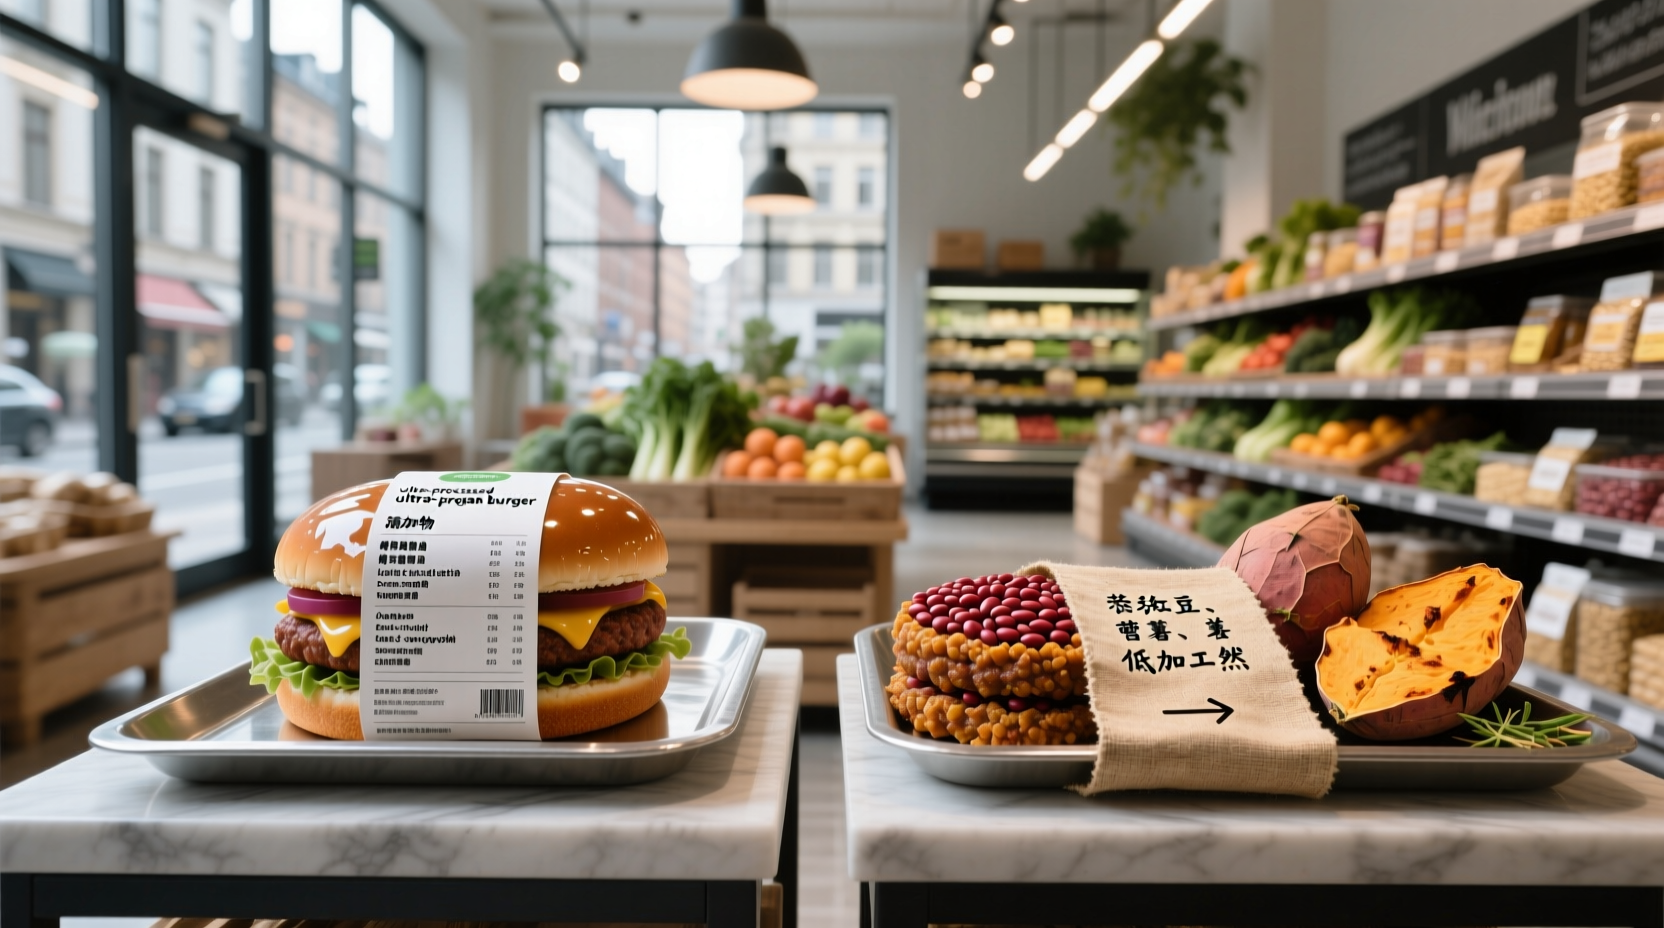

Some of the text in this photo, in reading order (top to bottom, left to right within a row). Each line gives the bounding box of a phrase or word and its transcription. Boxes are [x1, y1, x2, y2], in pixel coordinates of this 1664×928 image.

[487, 494, 537, 507] burger
[1122, 646, 1250, 675] 低加工然
